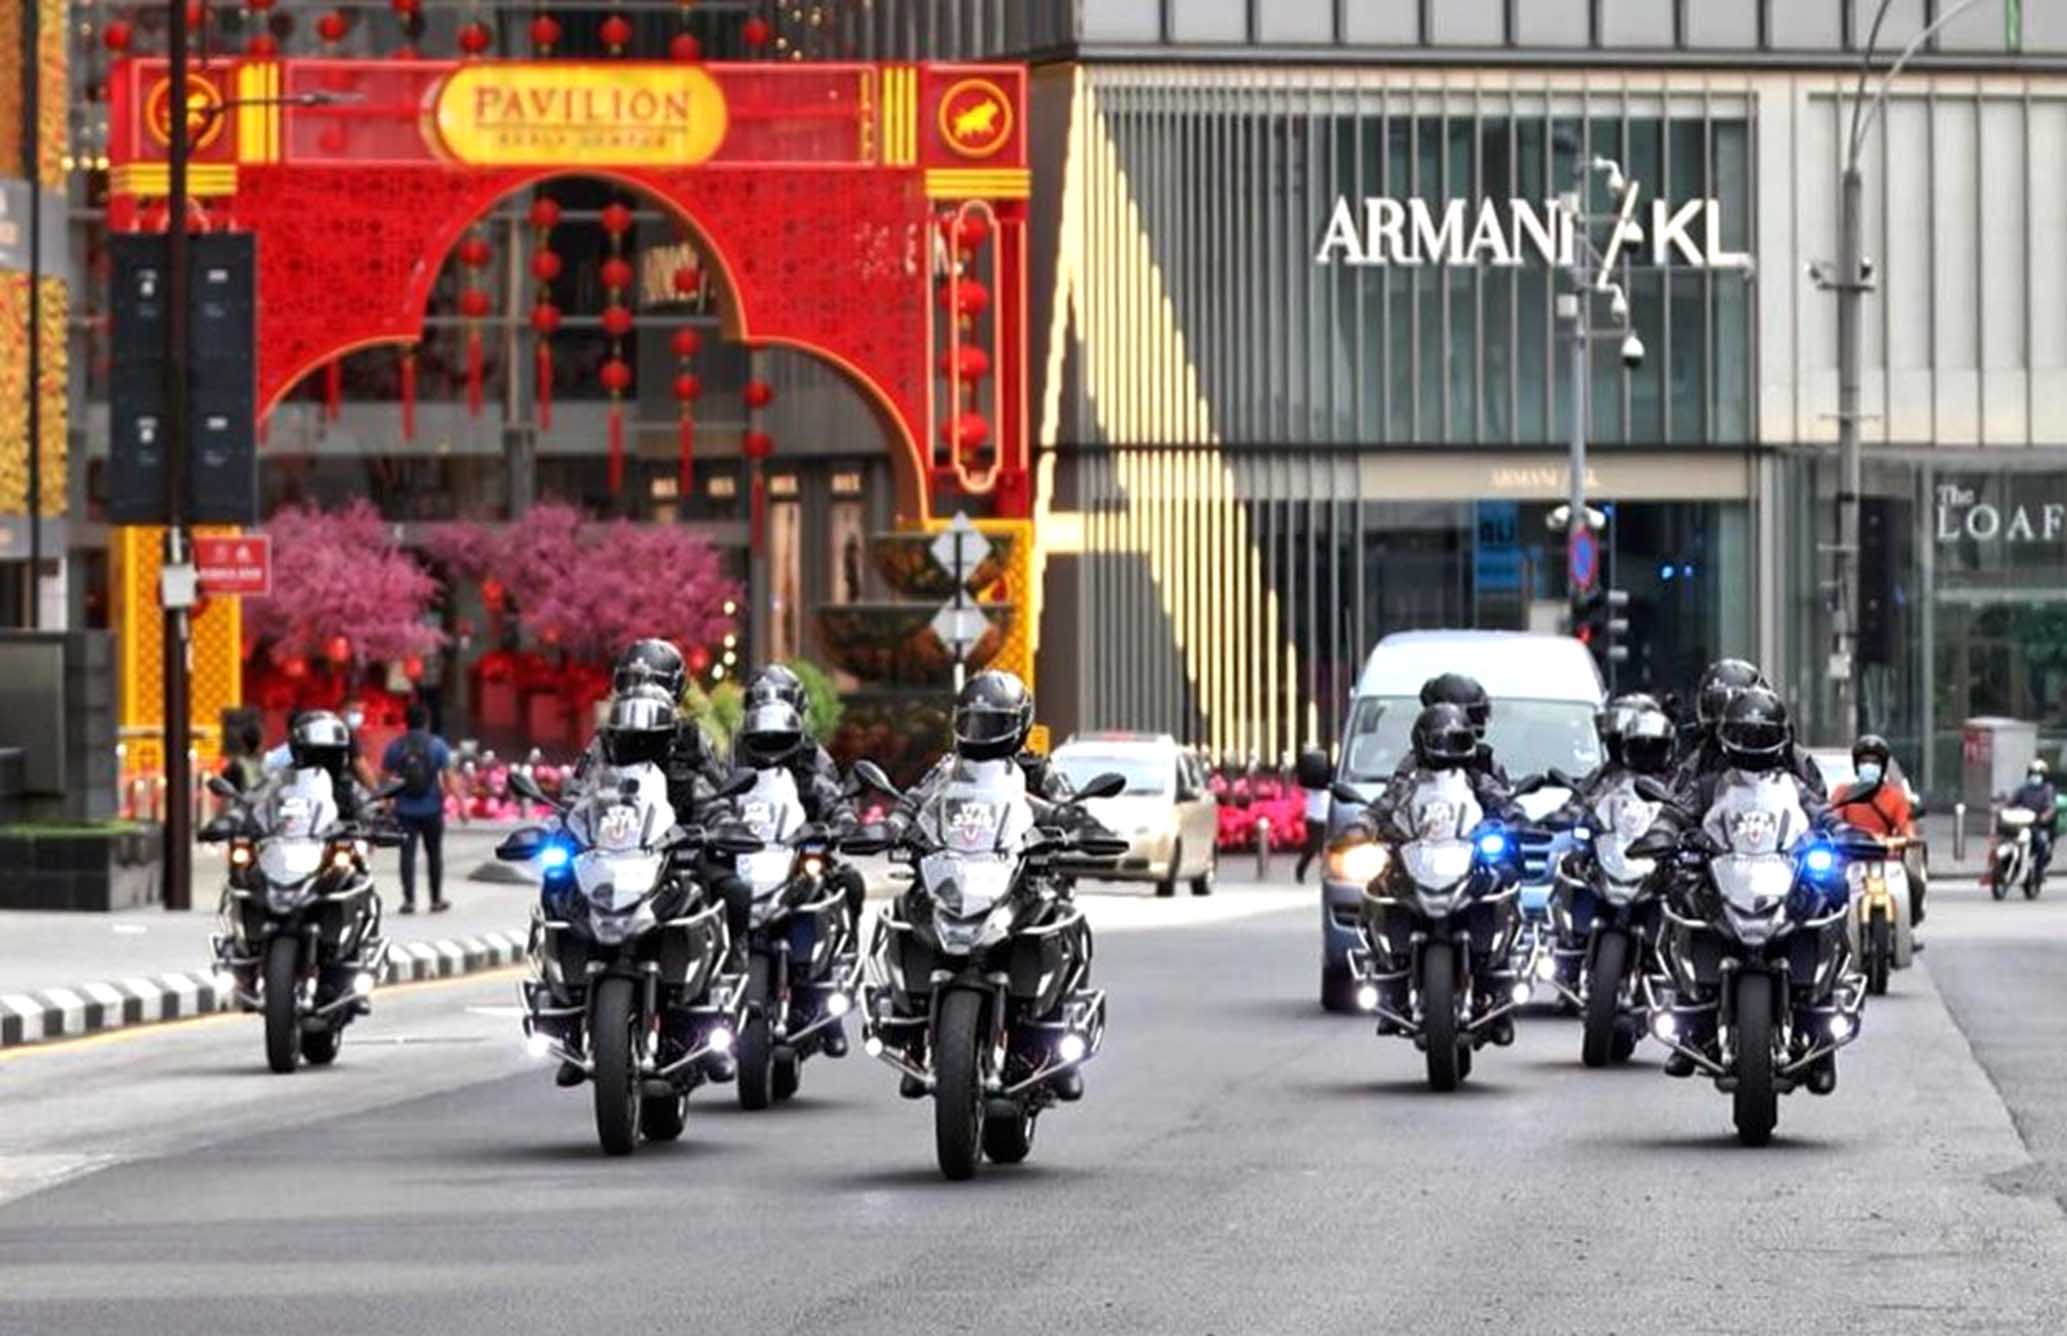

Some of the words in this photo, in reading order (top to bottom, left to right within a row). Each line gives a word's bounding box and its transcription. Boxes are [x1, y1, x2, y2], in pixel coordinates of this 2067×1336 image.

[473, 85, 692, 122] PAVILION
[1315, 193, 1575, 267] ARMANI
[1650, 197, 1751, 267] KL
[1936, 484, 1975, 504] The
[1937, 503, 2066, 542] LOAF
